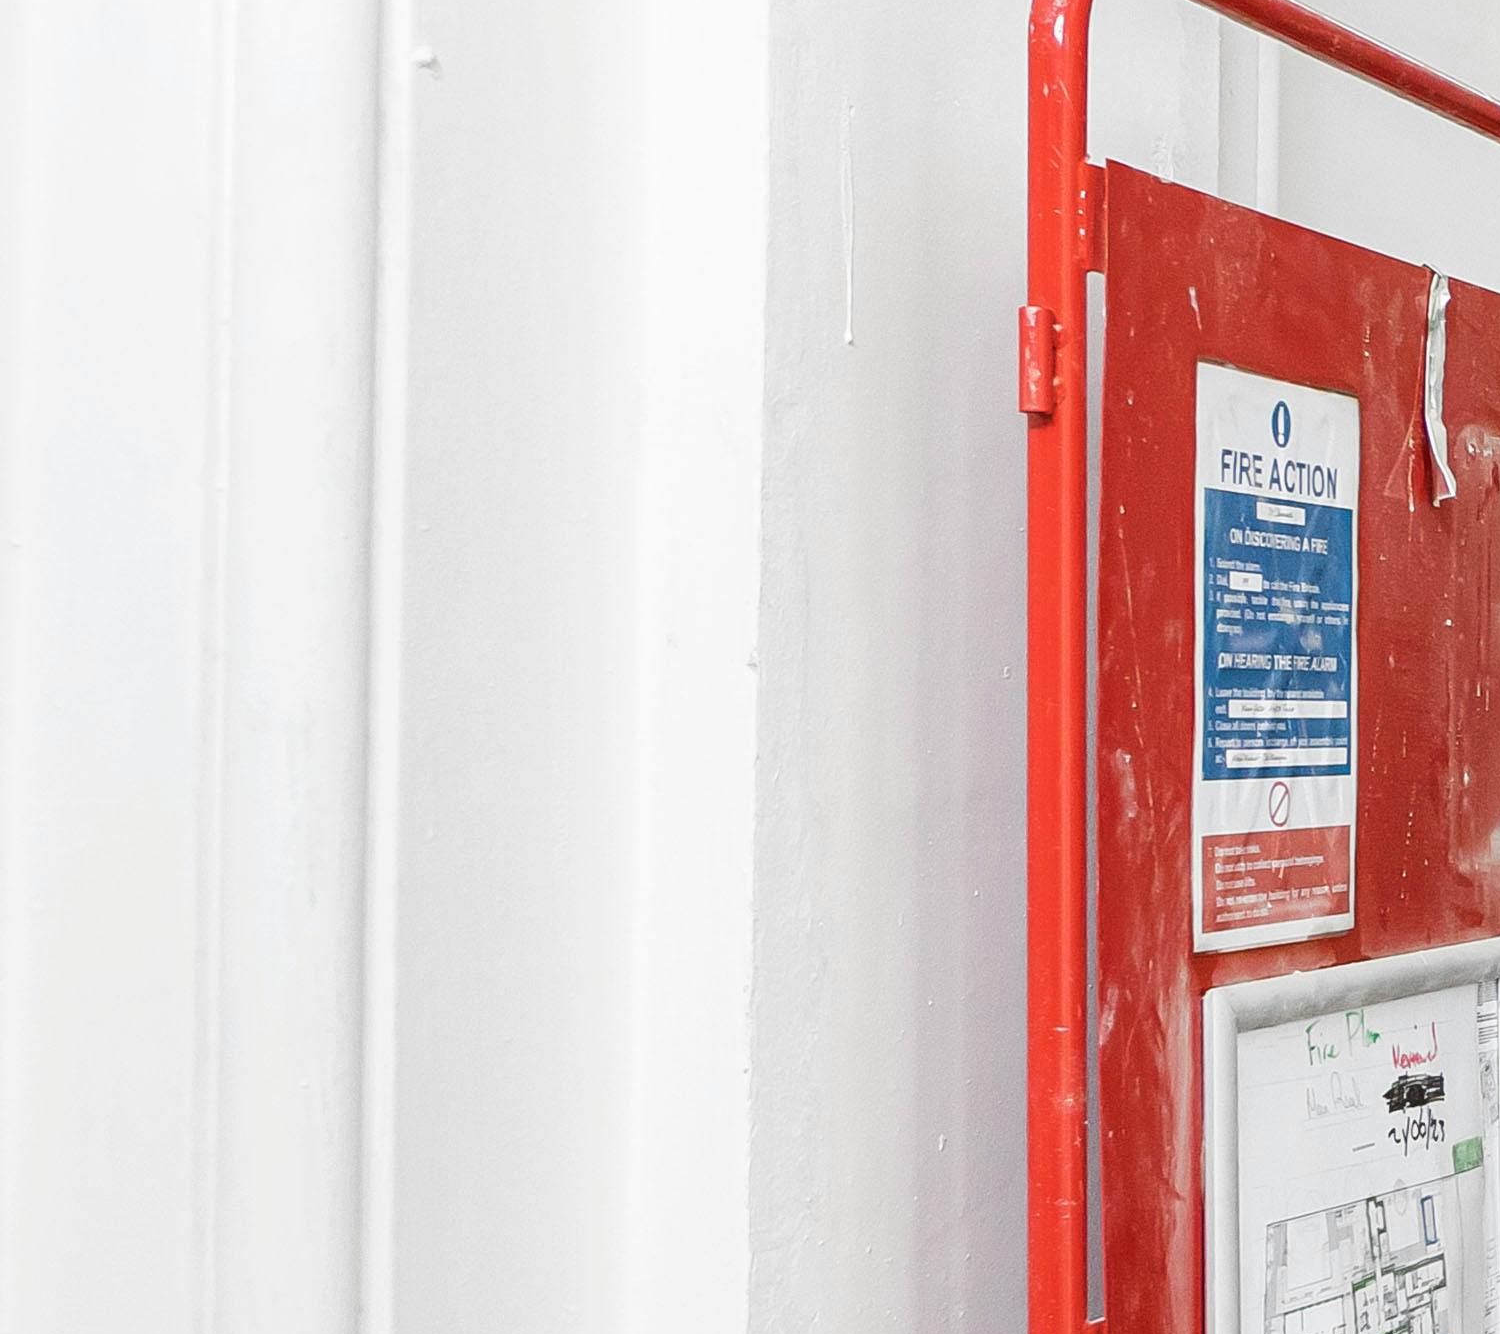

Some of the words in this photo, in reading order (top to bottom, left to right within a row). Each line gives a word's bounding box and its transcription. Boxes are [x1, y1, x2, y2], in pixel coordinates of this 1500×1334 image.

[1221, 448, 1263, 488] FIRE
[1269, 458, 1338, 499] ACTION
[1229, 528, 1243, 545] ON
[1302, 536, 1310, 552] A
[1218, 652, 1233, 669] ON
[1234, 652, 1272, 670] HEARING
[1273, 653, 1293, 670] THE
